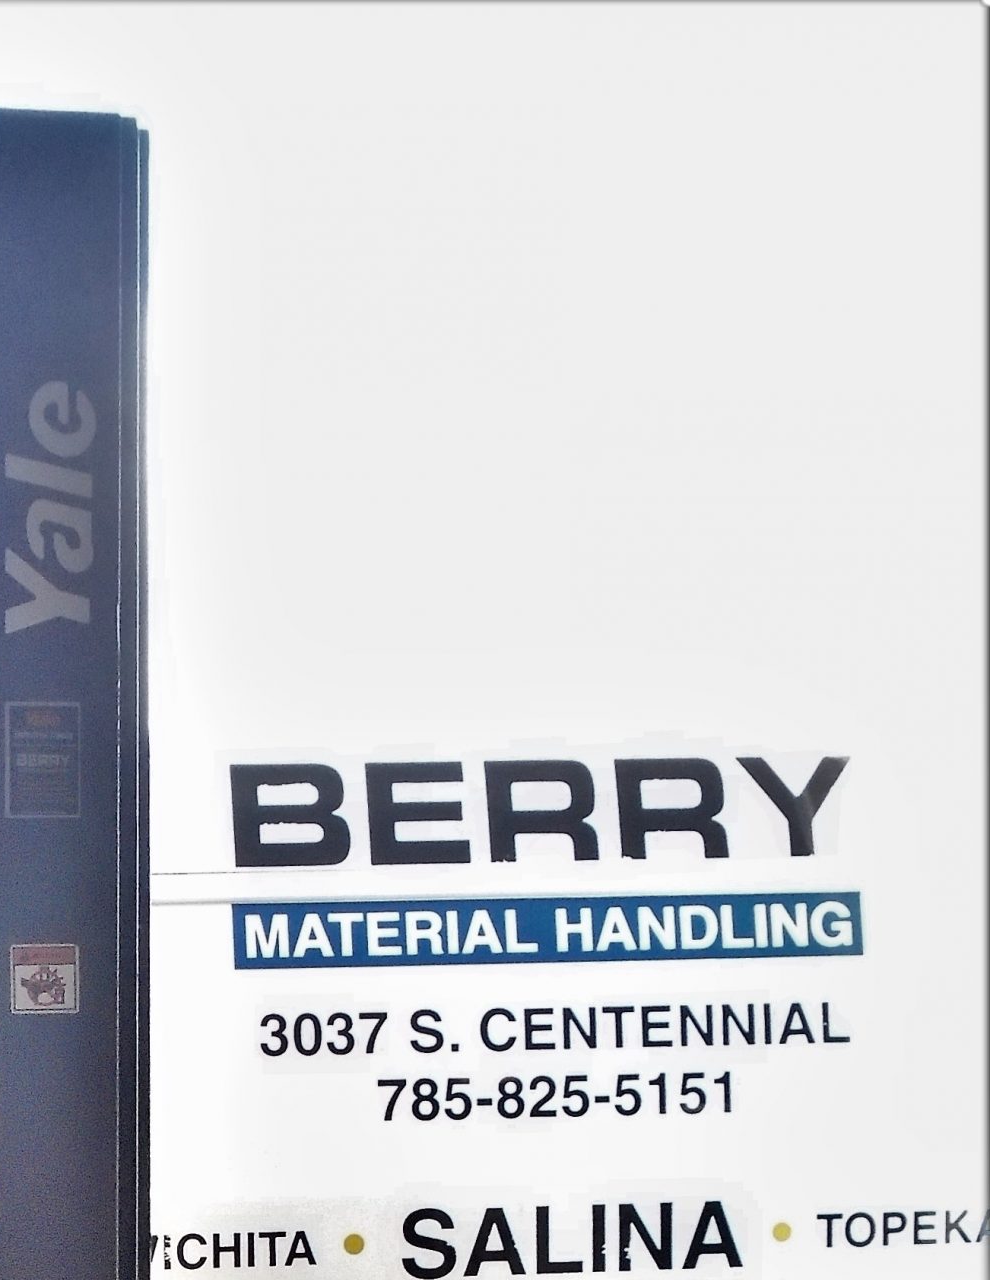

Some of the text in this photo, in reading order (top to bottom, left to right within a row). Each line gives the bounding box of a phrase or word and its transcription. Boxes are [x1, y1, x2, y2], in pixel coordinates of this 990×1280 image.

[4, 380, 97, 634] Yale
[230, 756, 850, 867] BERRY
[244, 901, 854, 959] MATERIAL HANDLING
[259, 1002, 851, 1056] 3037 S. CENTENNIAL
[377, 1071, 733, 1121] 785-825-5151
[150, 1230, 317, 1270] ICHITA
[401, 1200, 743, 1280] SALINA
